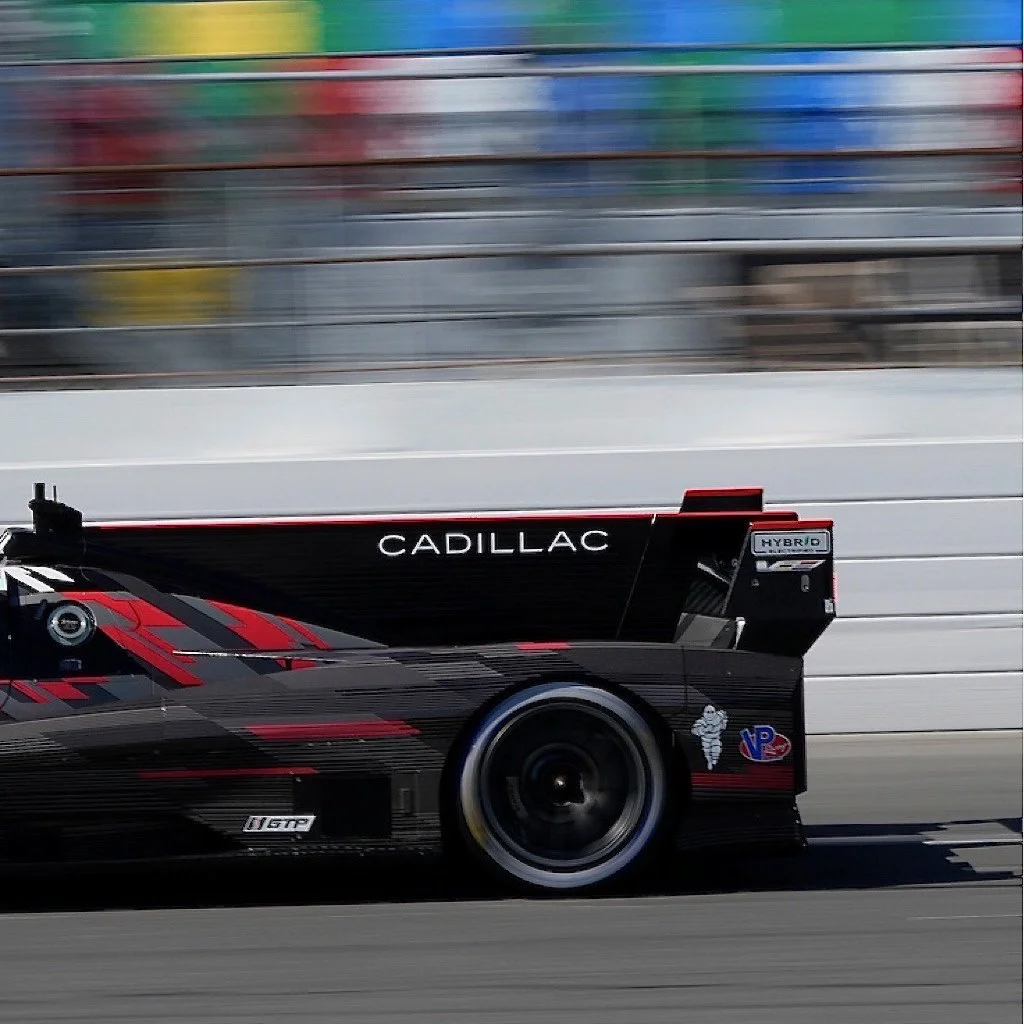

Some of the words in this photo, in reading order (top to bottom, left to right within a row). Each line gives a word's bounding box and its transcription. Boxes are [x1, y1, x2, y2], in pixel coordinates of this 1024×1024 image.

[378, 530, 609, 556] CADILLAC
[761, 536, 820, 547] HYBRID
[739, 725, 776, 760] VP
